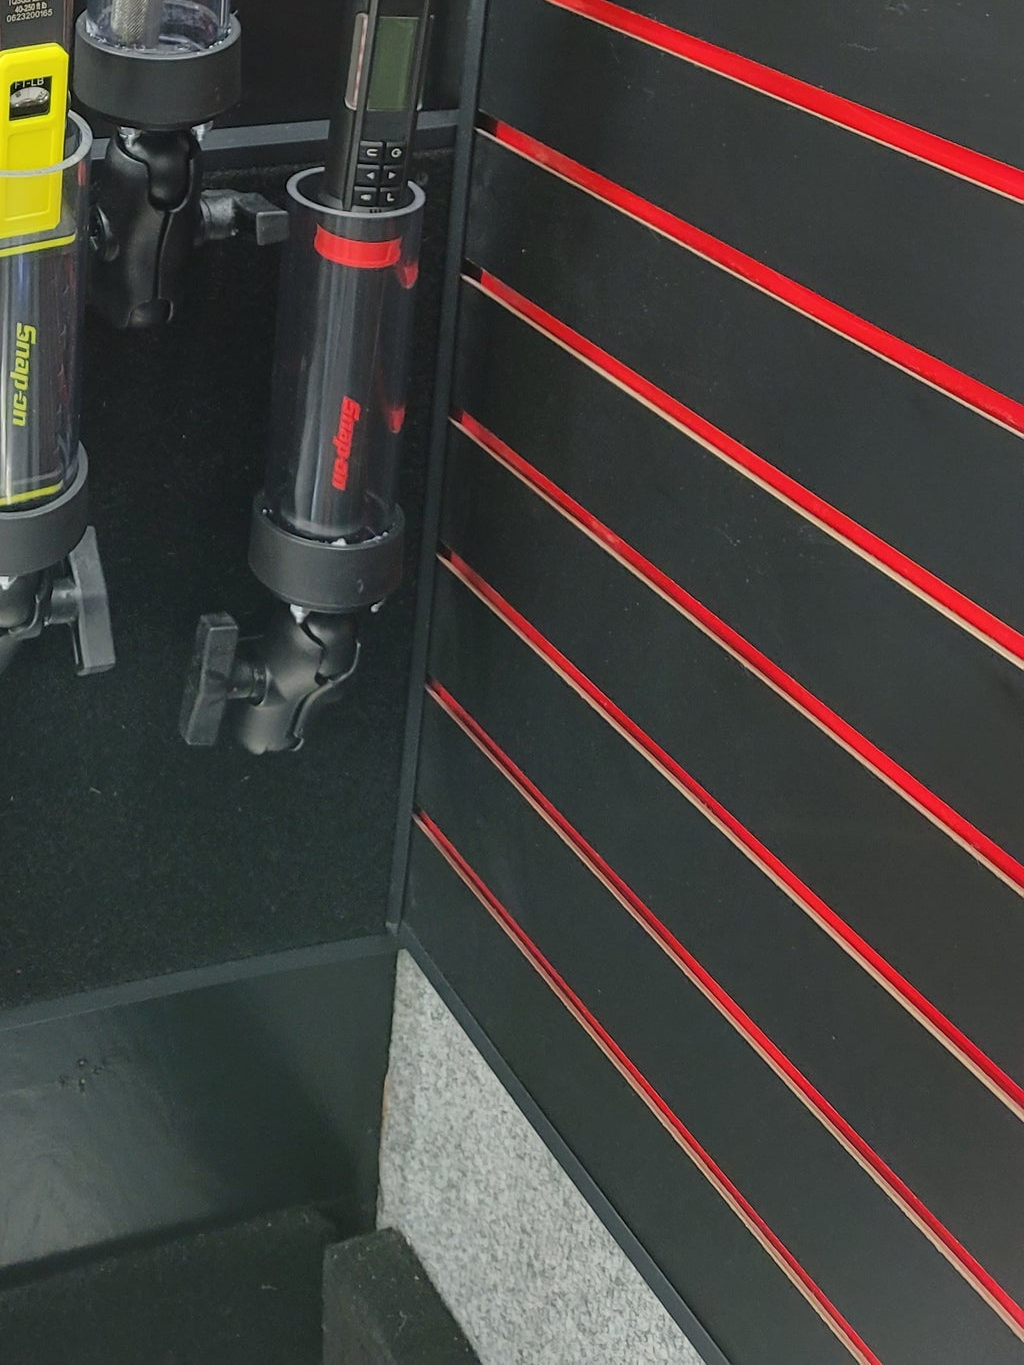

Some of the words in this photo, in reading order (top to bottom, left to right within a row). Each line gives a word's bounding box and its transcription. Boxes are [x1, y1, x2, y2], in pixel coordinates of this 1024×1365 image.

[6, 8, 53, 23] 0623200165
[9, 322, 37, 427] Snap-on
[332, 395, 361, 491] Snap-on
